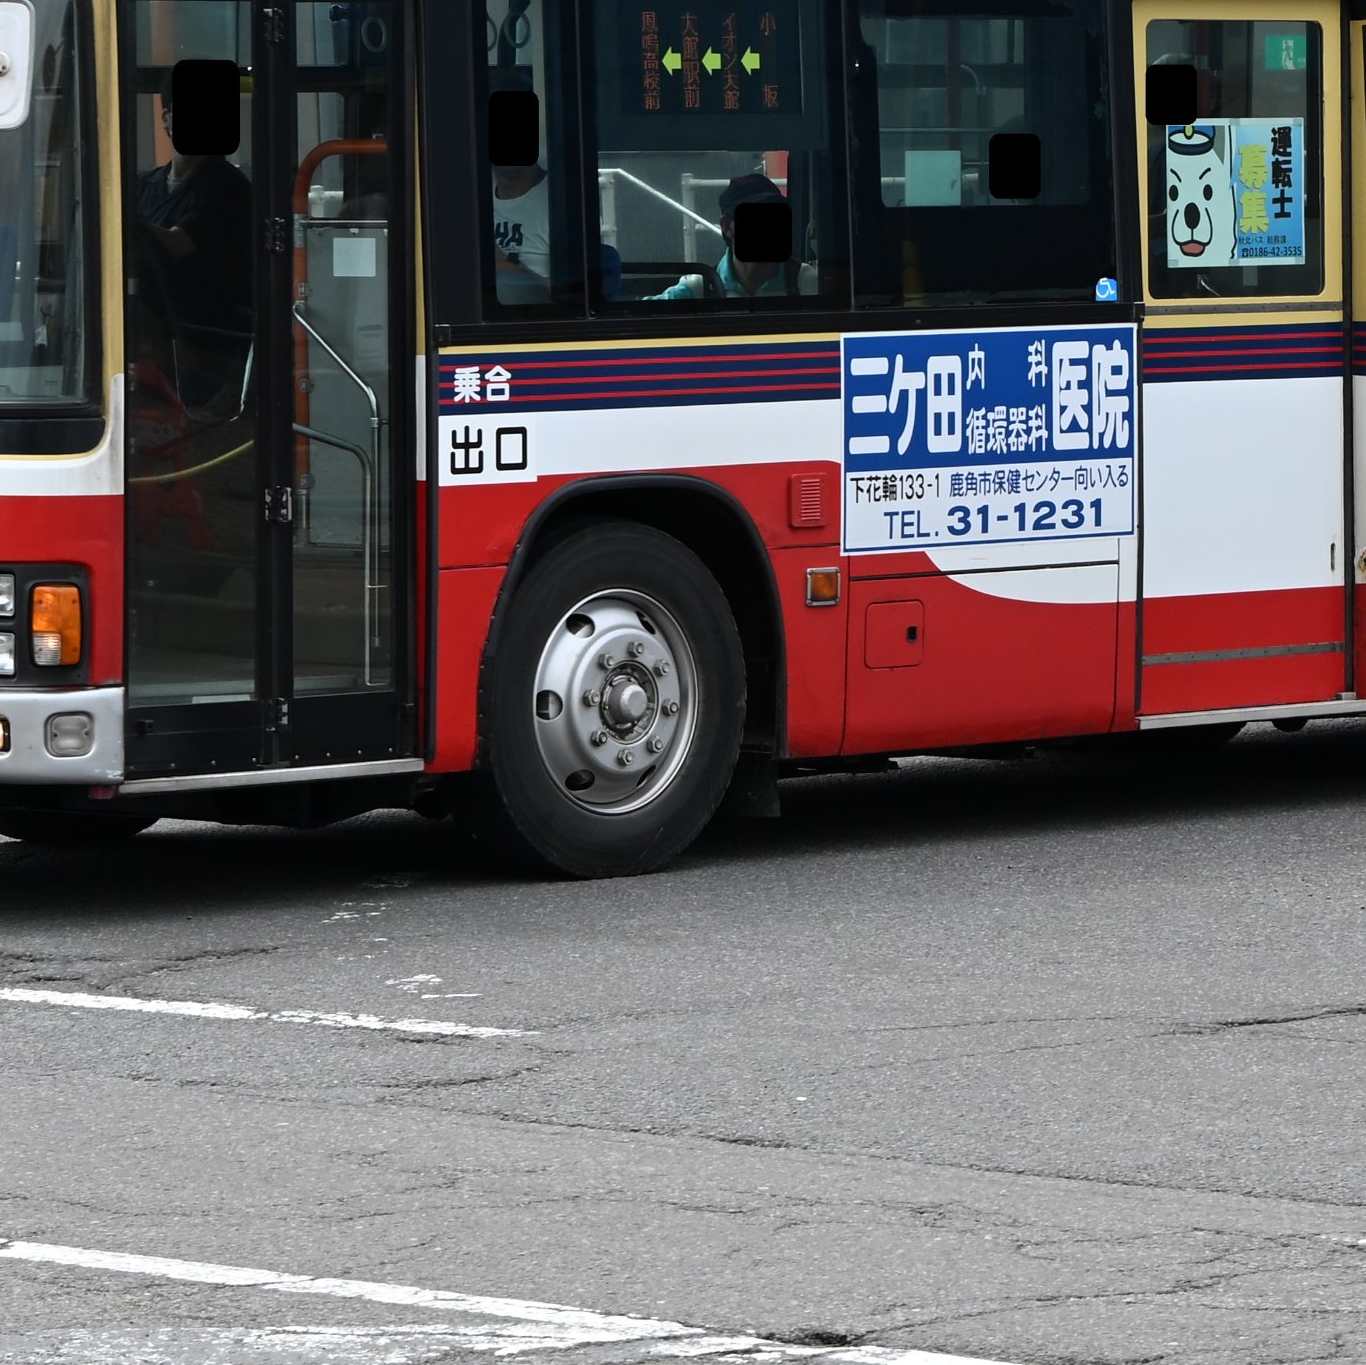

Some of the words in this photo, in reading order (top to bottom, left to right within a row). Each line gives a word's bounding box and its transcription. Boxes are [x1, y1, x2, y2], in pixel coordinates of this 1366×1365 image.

[1238, 143, 1269, 234] 募集
[1271, 126, 1293, 218] 運転士
[453, 365, 512, 404] 乗合
[966, 403, 1049, 455] 循環器科
[1052, 339, 1129, 451] 医院
[450, 425, 528, 475] 出口
[850, 473, 940, 504] 下花輪133-1
[949, 464, 1129, 498] 鹿角市保健センター向い入る
[884, 510, 939, 540] TEL.
[947, 498, 1103, 536] 31-1231
